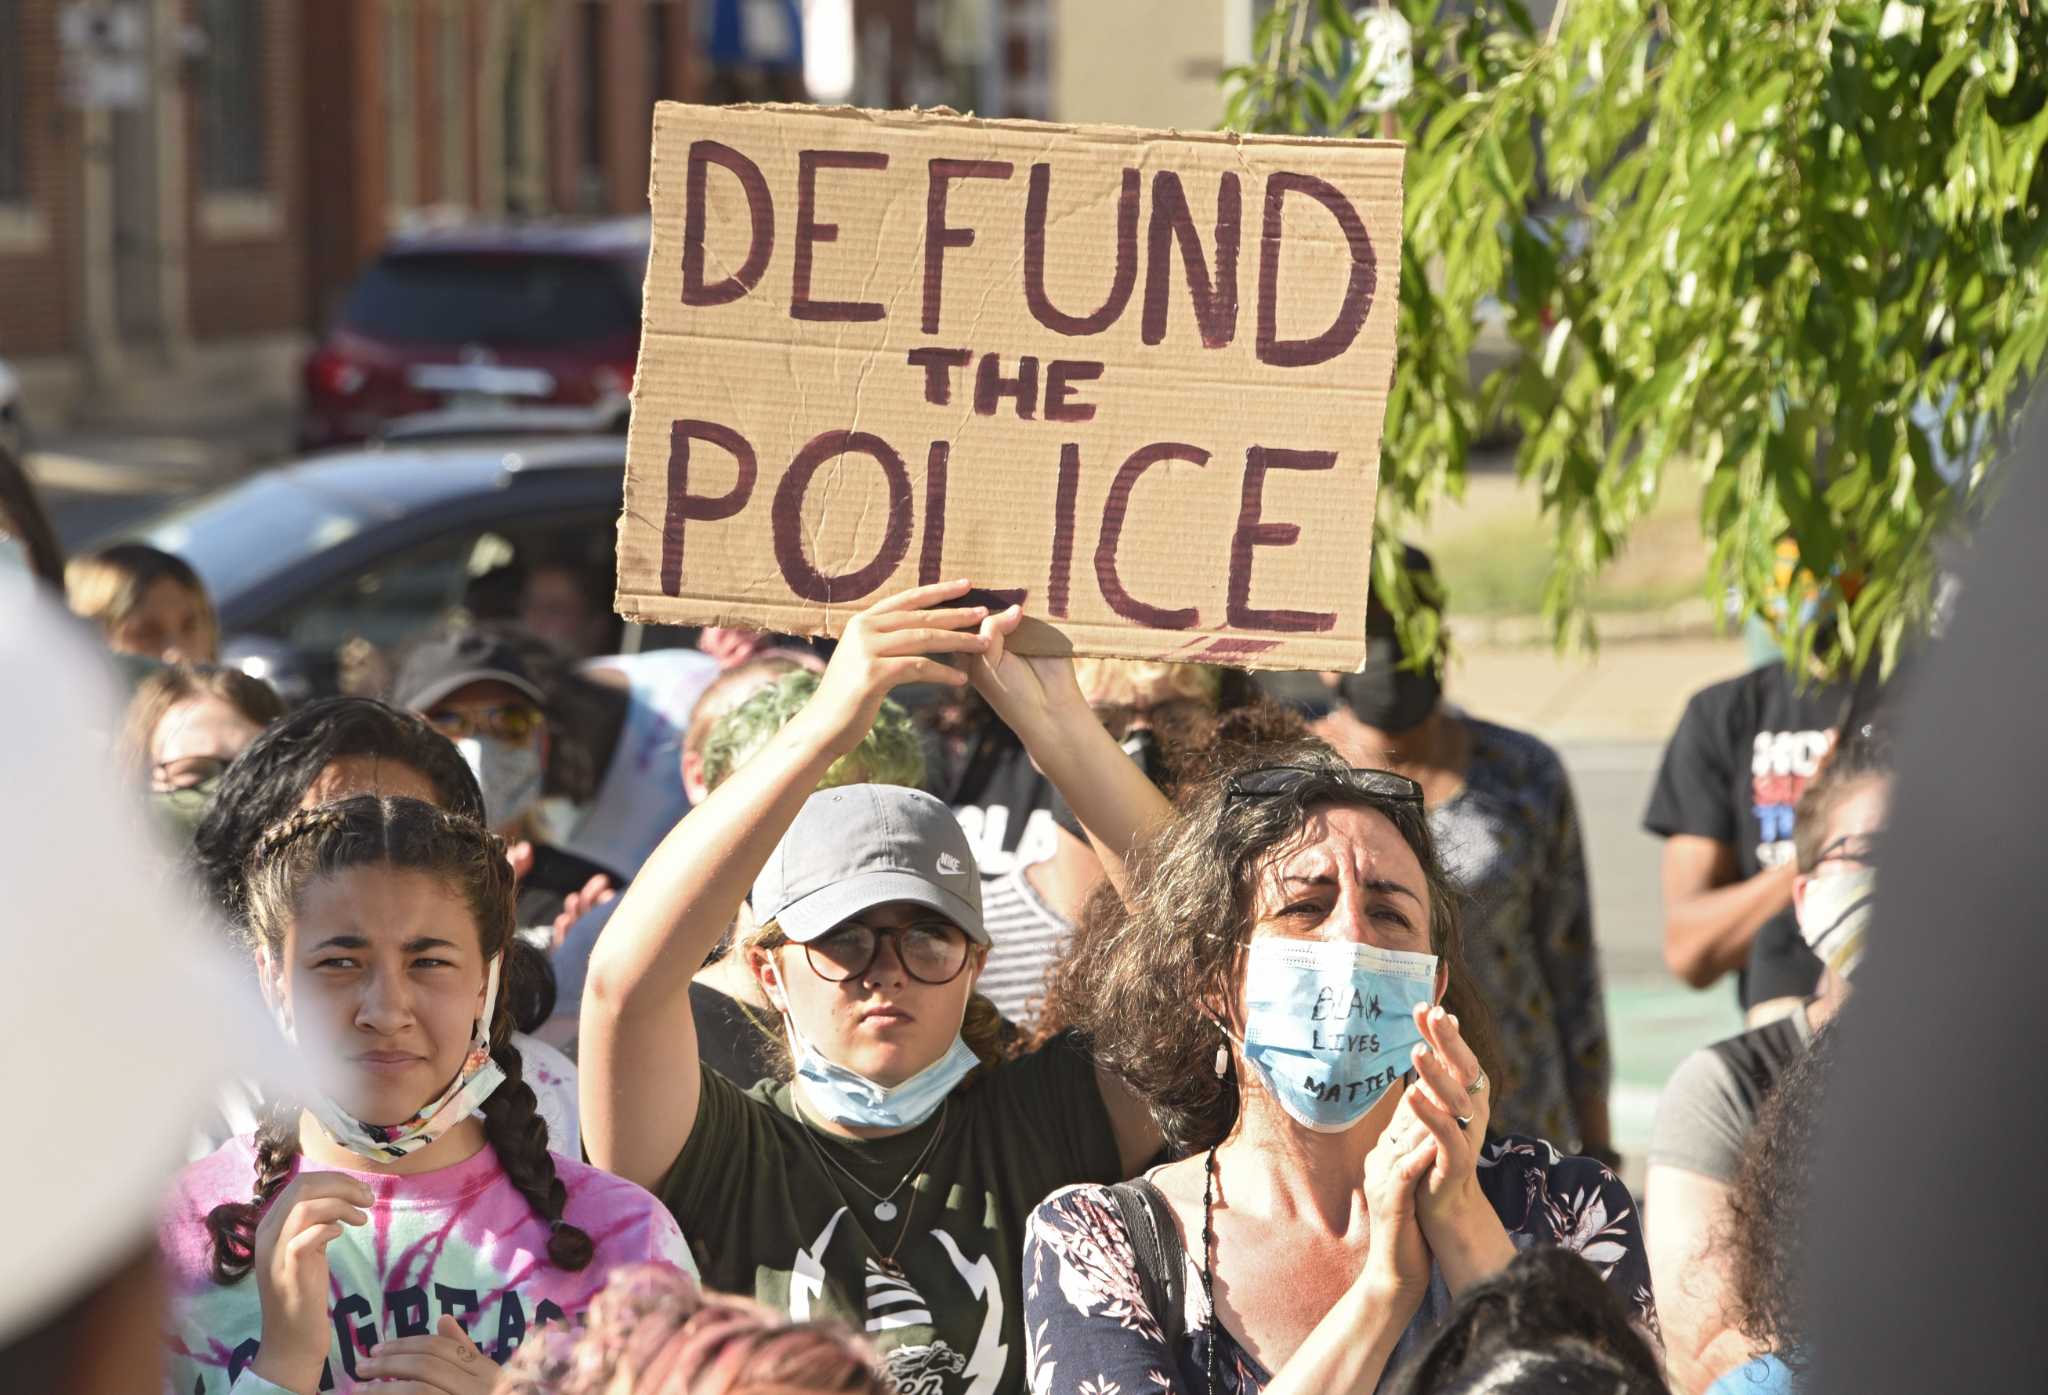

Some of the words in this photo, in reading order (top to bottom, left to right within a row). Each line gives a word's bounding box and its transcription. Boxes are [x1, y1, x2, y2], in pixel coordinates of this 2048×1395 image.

[681, 140, 1378, 366] DEFUND
[907, 347, 1104, 421] THE
[660, 419, 1339, 632] POLICE
[940, 852, 961, 872] NIKE
[1312, 1029, 1380, 1052] LIVES
[1303, 1065, 1397, 1103] MATTER
